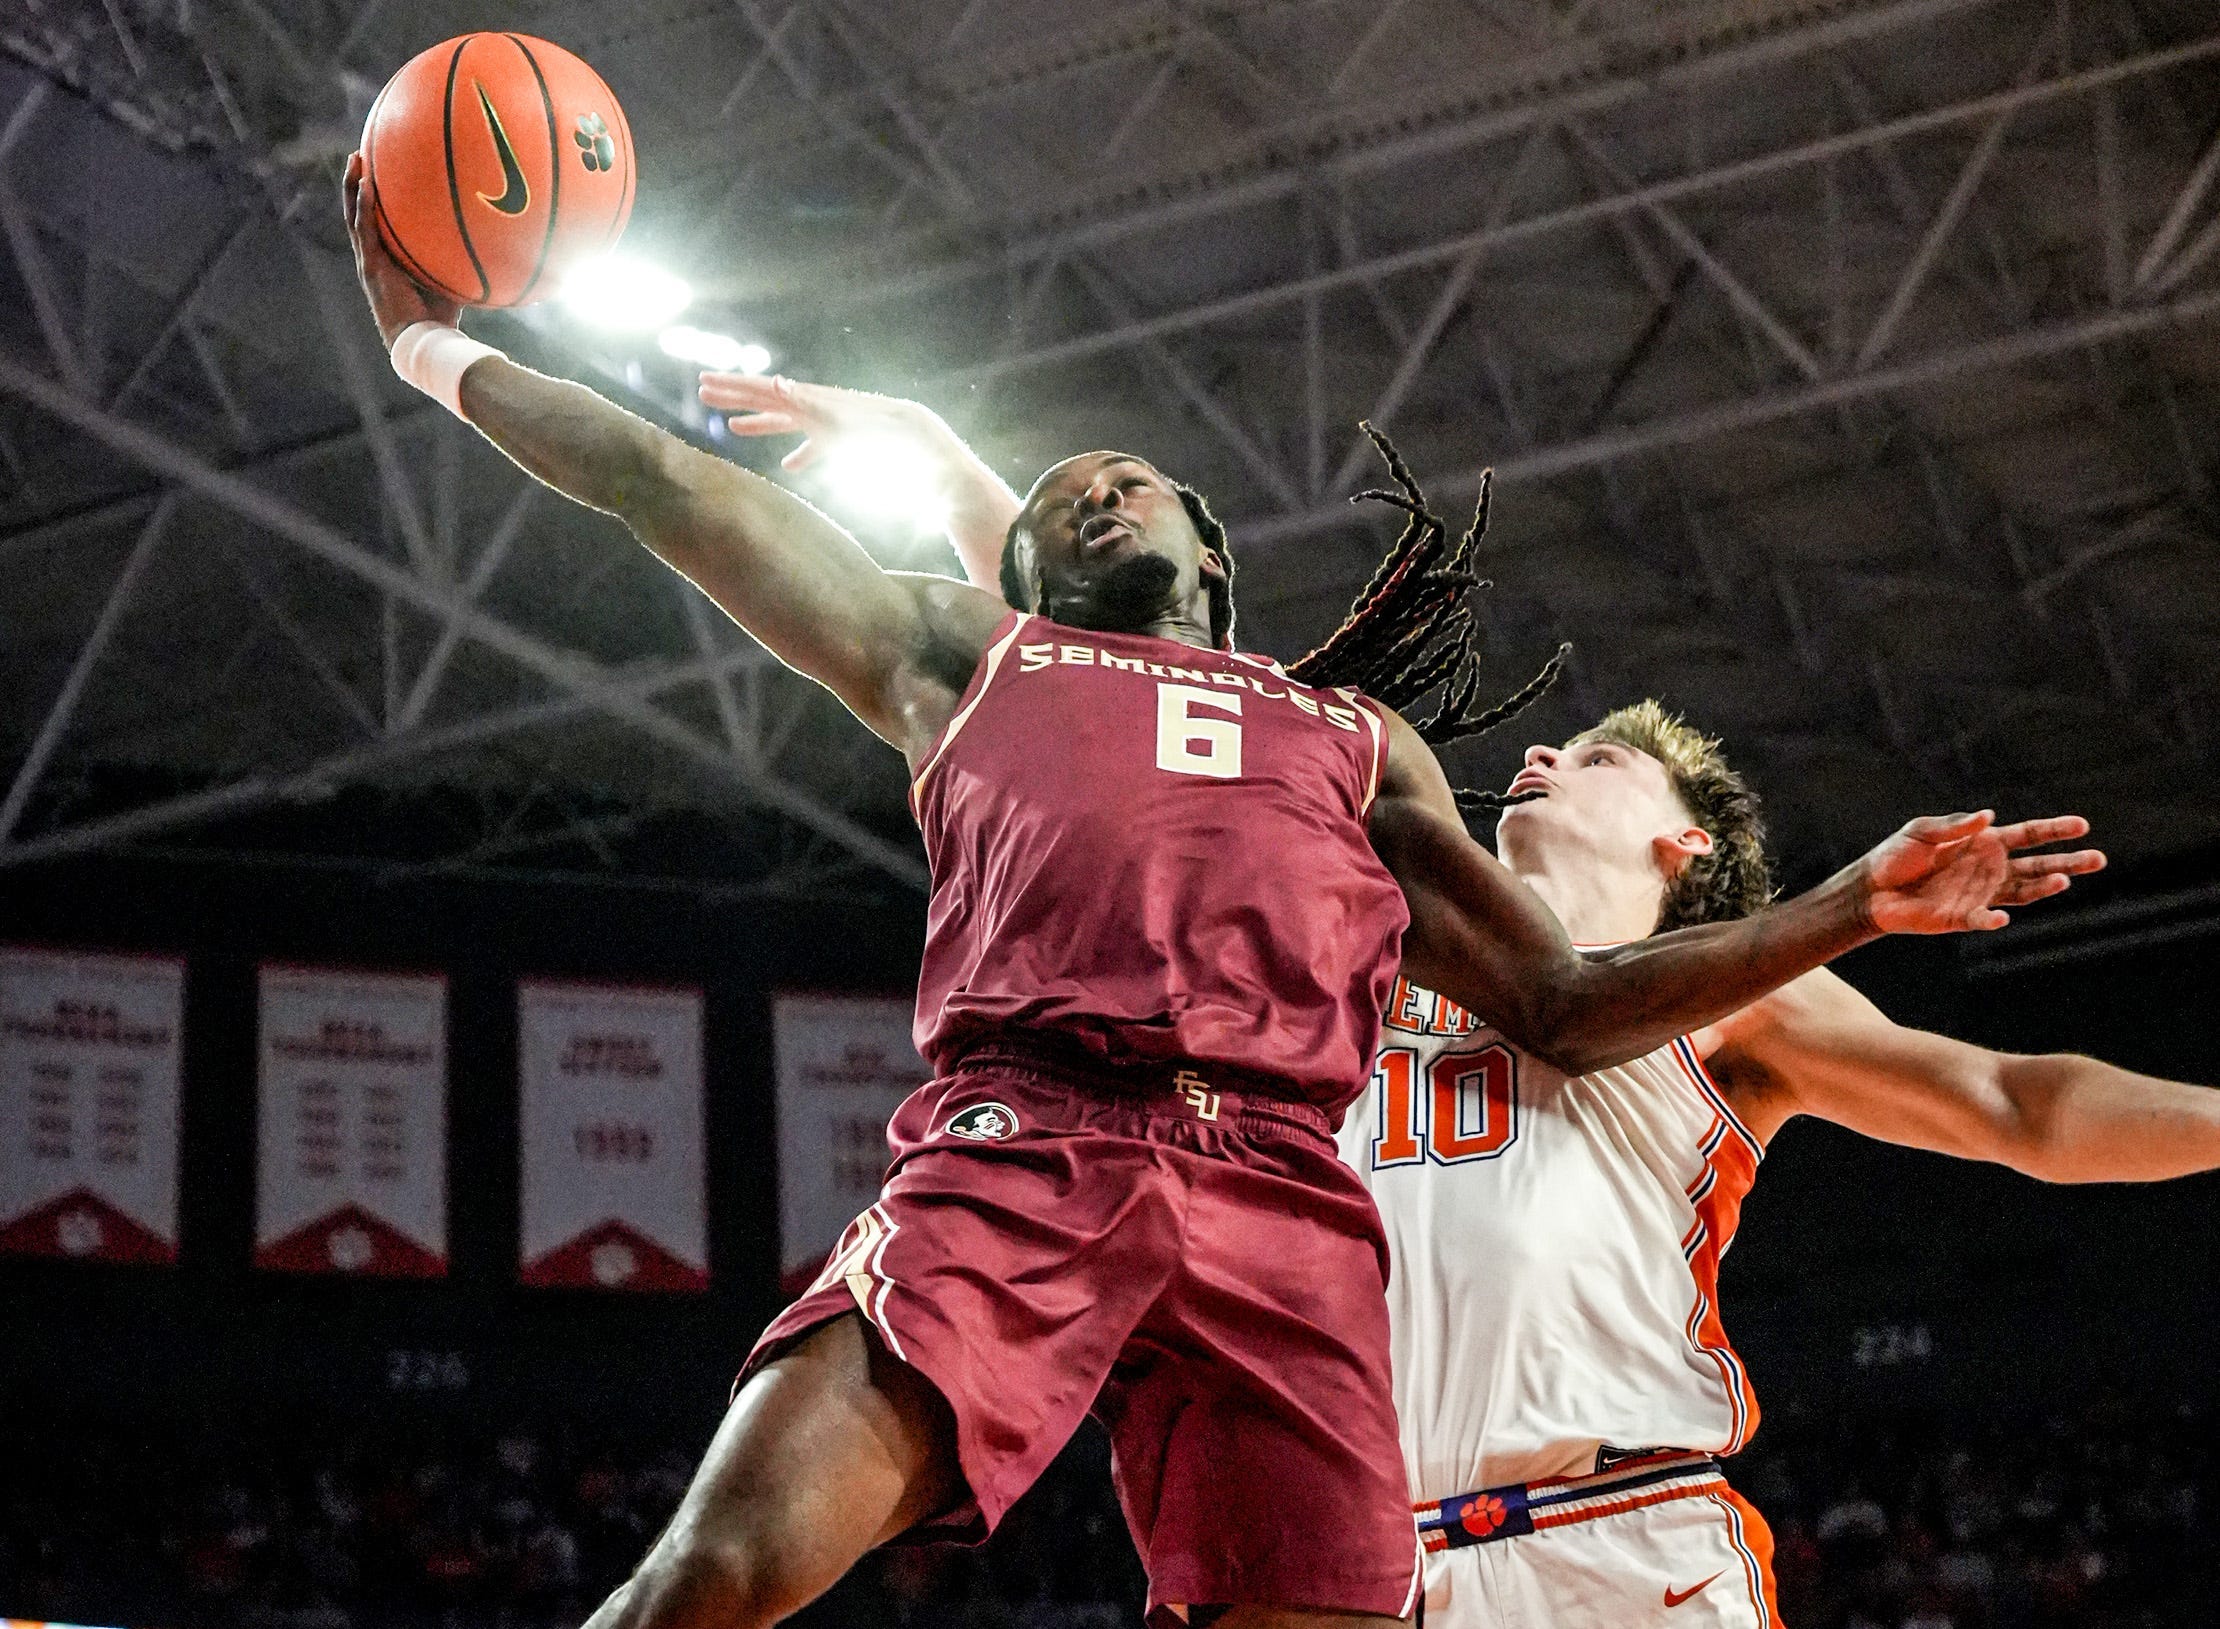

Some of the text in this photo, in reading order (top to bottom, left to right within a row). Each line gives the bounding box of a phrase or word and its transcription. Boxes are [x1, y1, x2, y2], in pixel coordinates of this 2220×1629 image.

[1018, 643, 1361, 733] SEMINOLES
[1156, 682, 1243, 778] 6
[1173, 1070, 1220, 1121] FSU
[1372, 1042, 1518, 1172] 10
